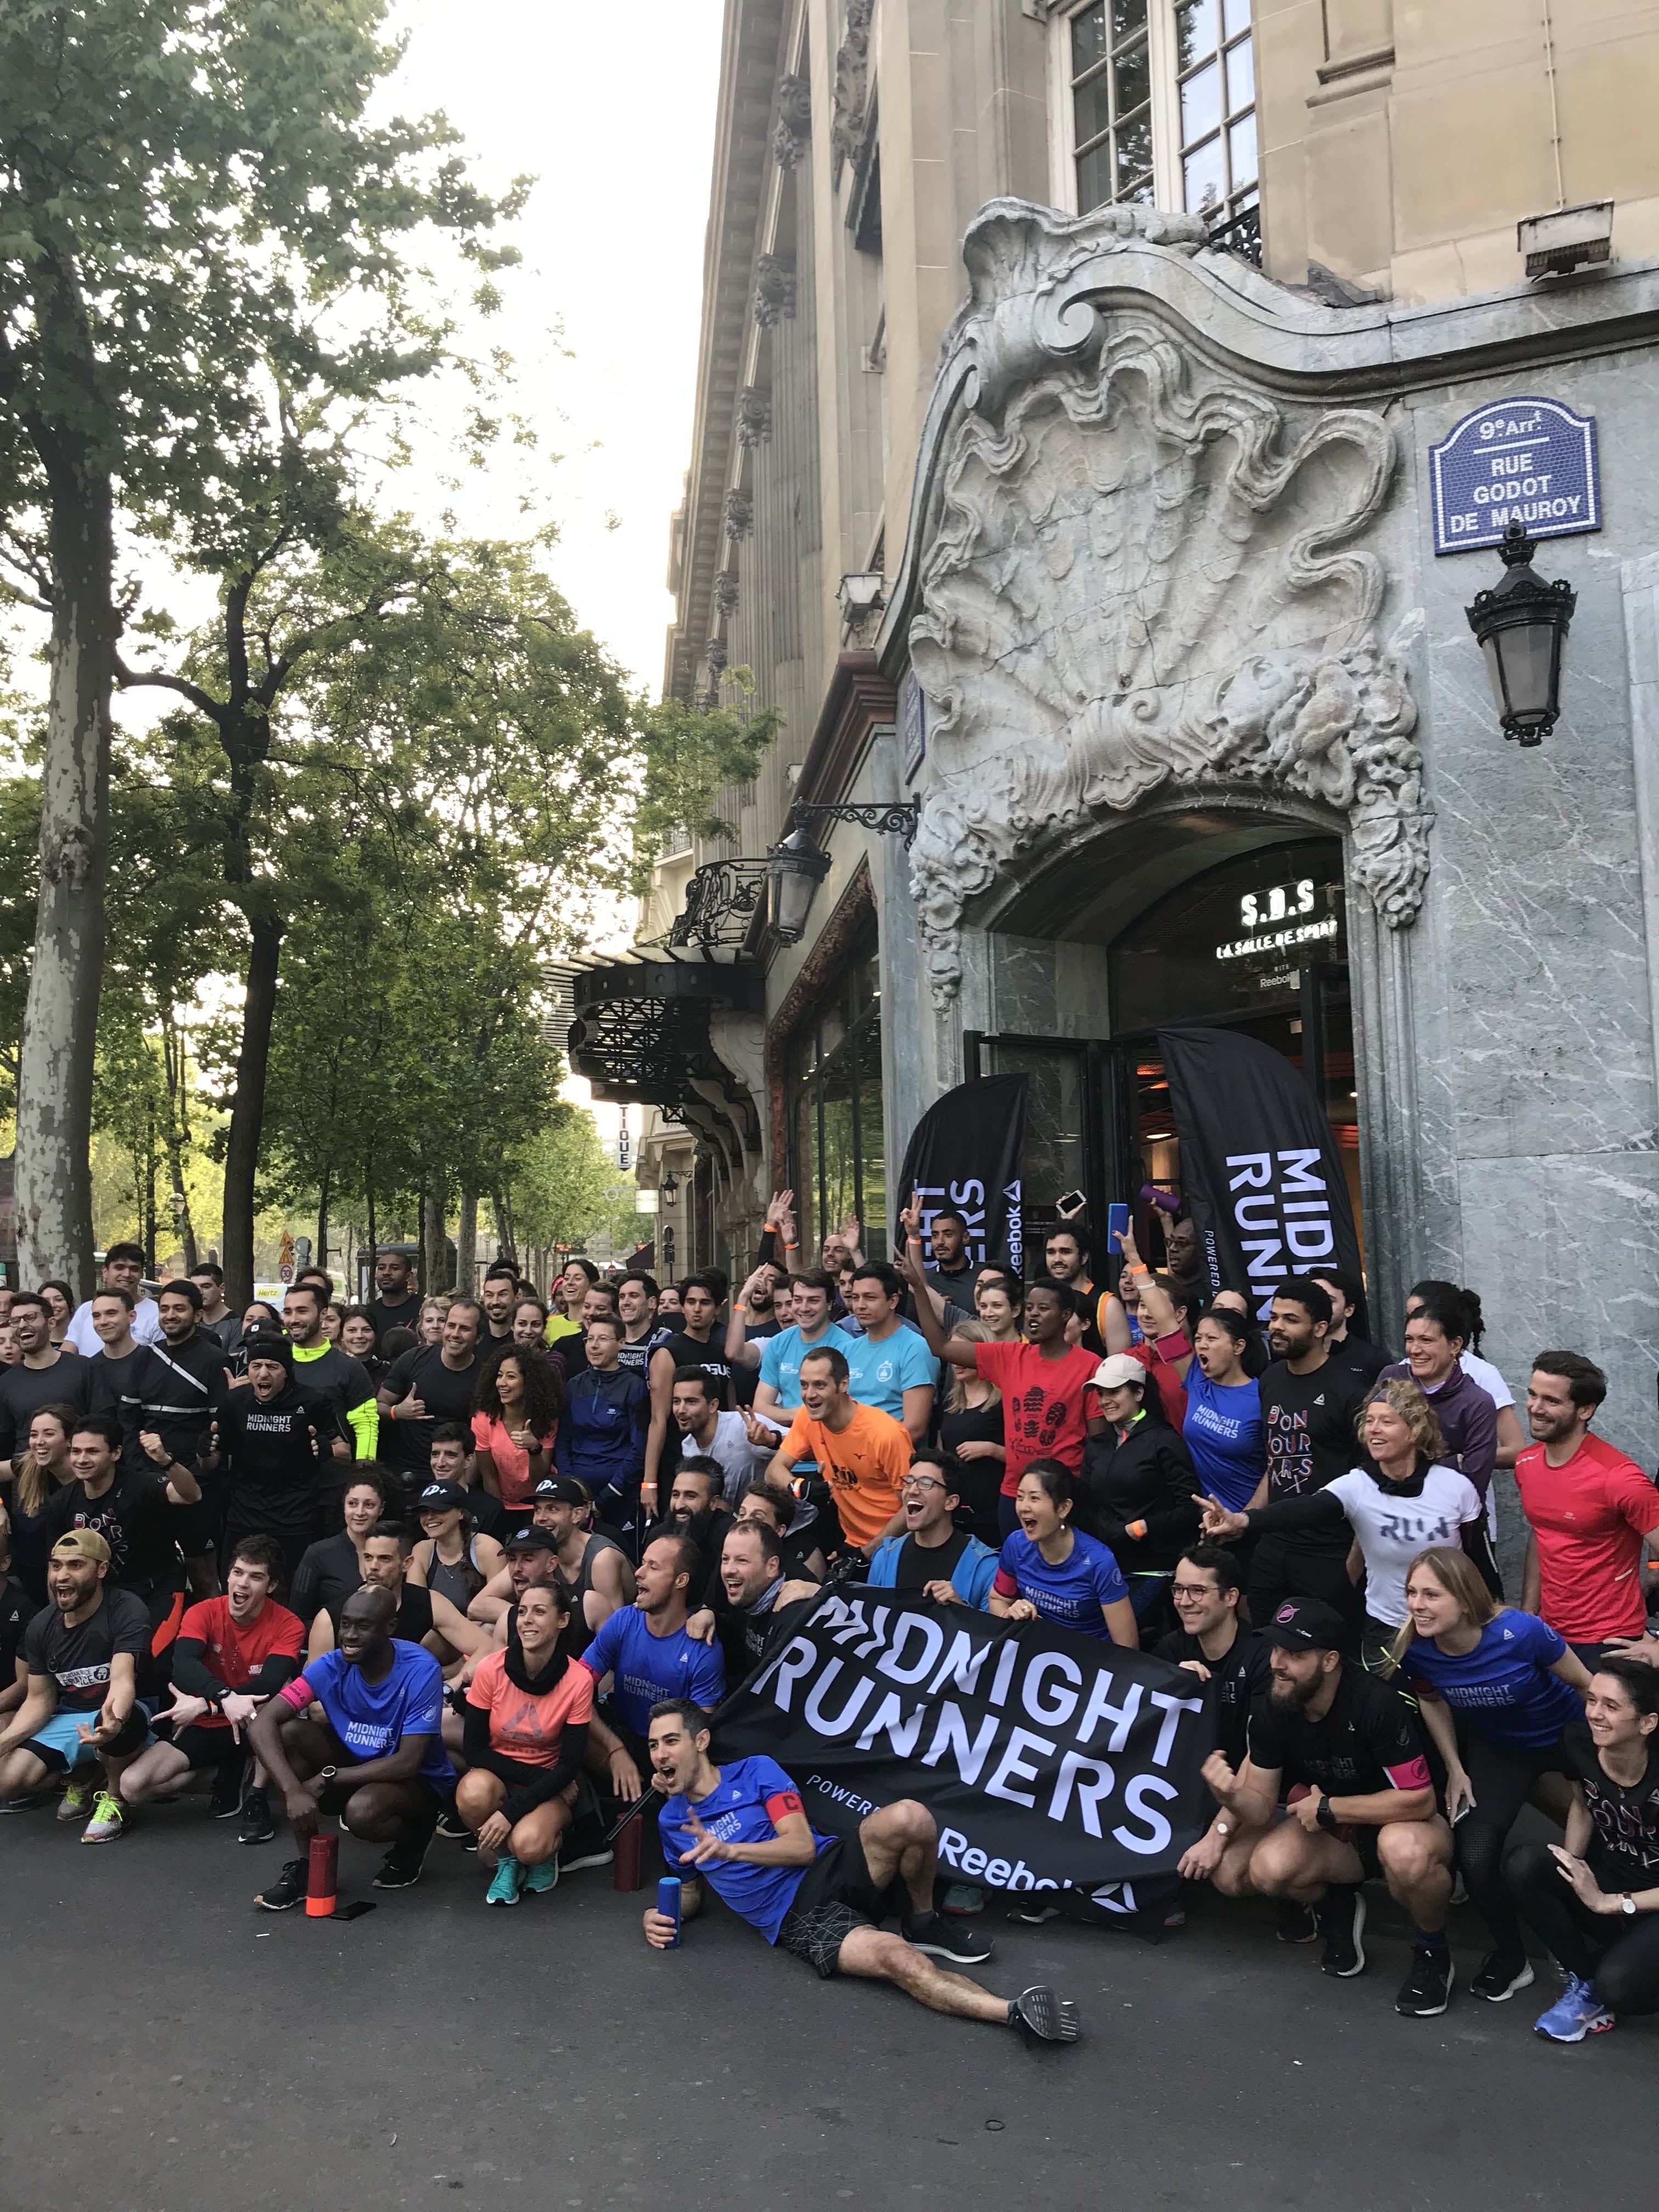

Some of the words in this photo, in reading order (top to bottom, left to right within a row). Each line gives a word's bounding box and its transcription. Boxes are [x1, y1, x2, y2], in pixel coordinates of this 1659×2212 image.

[1491, 453, 1533, 477] RUE
[1473, 475, 1552, 504] GODOT
[1450, 512, 1479, 533] DE
[1491, 495, 1582, 527] MAUROY
[1216, 944, 1234, 959] LA
[1234, 935, 1275, 955] SALLE
[1276, 930, 1296, 946] DE
[1296, 921, 1338, 943] SPORT
[1204, 1230, 1221, 1287] POWERED
[246, 1422, 291, 1432] RUNNERS
[247, 1414, 292, 1424] MIDNIGHT
[1191, 1412, 1239, 1439] RUNNERS
[1025, 1585, 1079, 1610] MIDNIGHT
[806, 1595, 1204, 1768] MIDNIGHT
[1445, 1684, 1510, 1698] MIDNIGHT
[345, 1731, 396, 1748] RUNNERS
[751, 1636, 1180, 1855] RUNNERS
[782, 1795, 799, 1810] C
